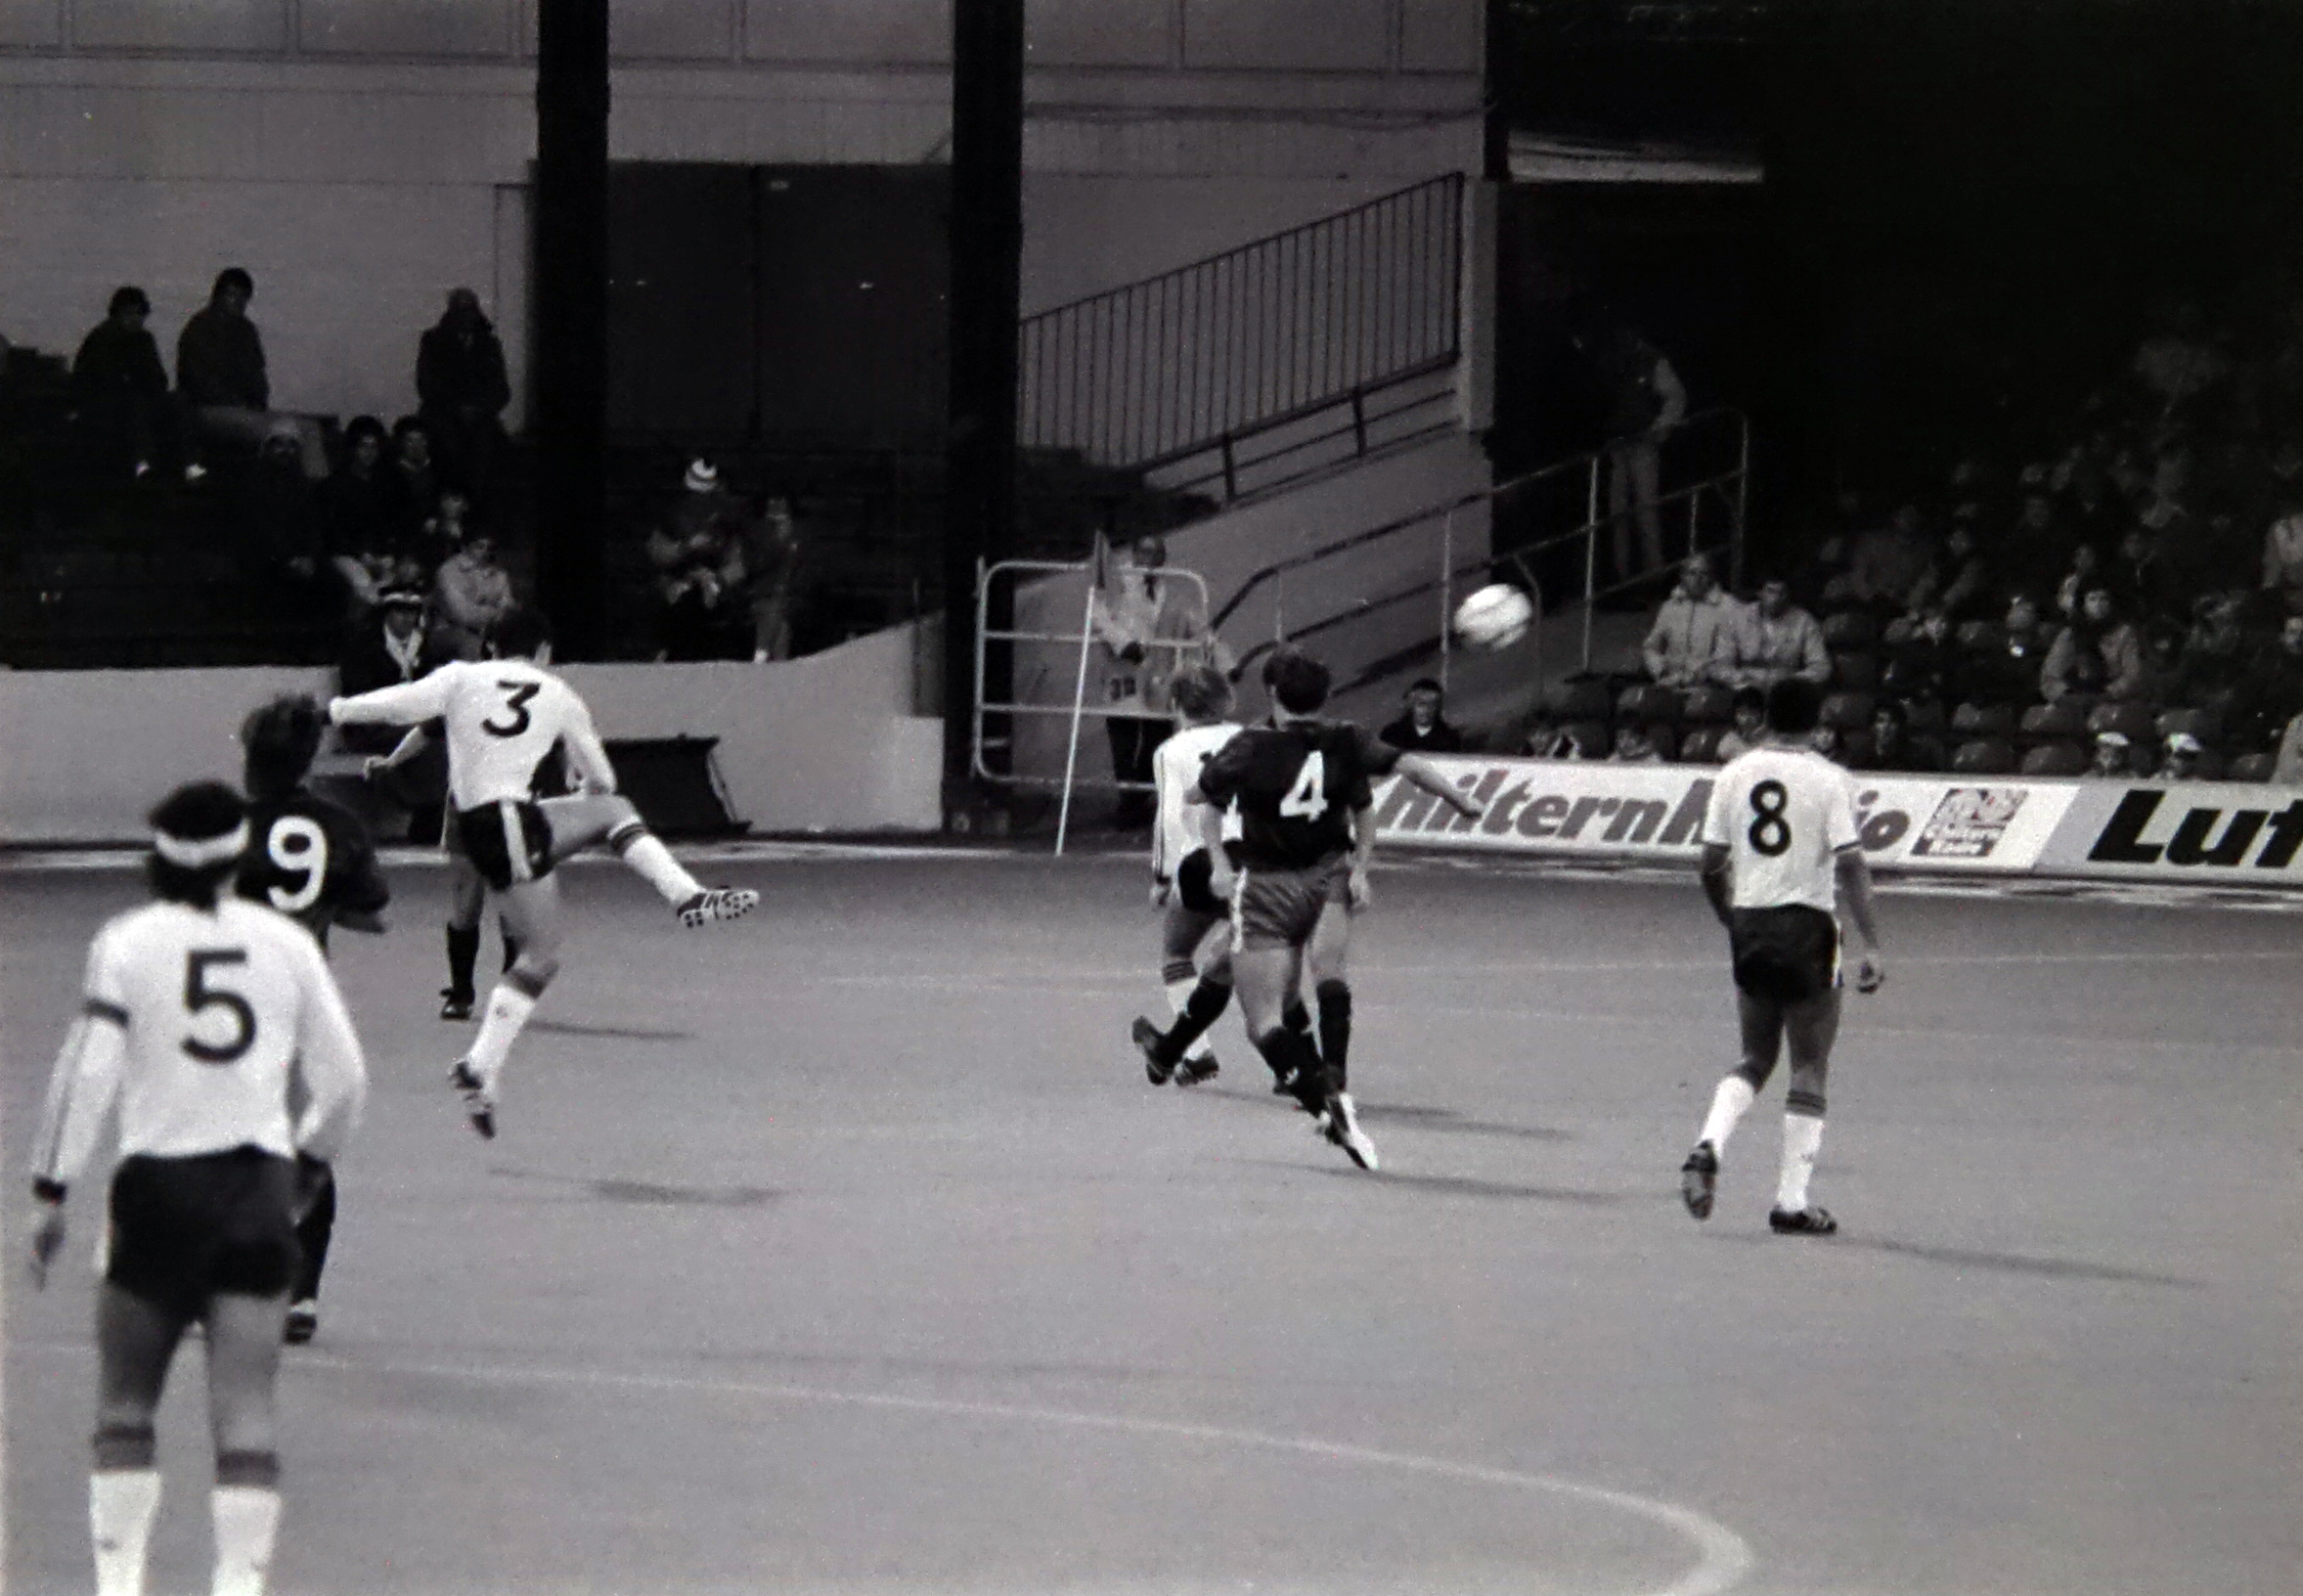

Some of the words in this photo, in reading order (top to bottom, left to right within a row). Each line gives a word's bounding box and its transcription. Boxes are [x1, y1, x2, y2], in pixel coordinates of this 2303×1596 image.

[482, 681, 540, 737] 3
[1280, 750, 1328, 820] 4
[1369, 770, 1668, 844] hiltern
[1749, 779, 1792, 857] 8
[267, 816, 327, 911] 9
[181, 950, 256, 1064] 5
